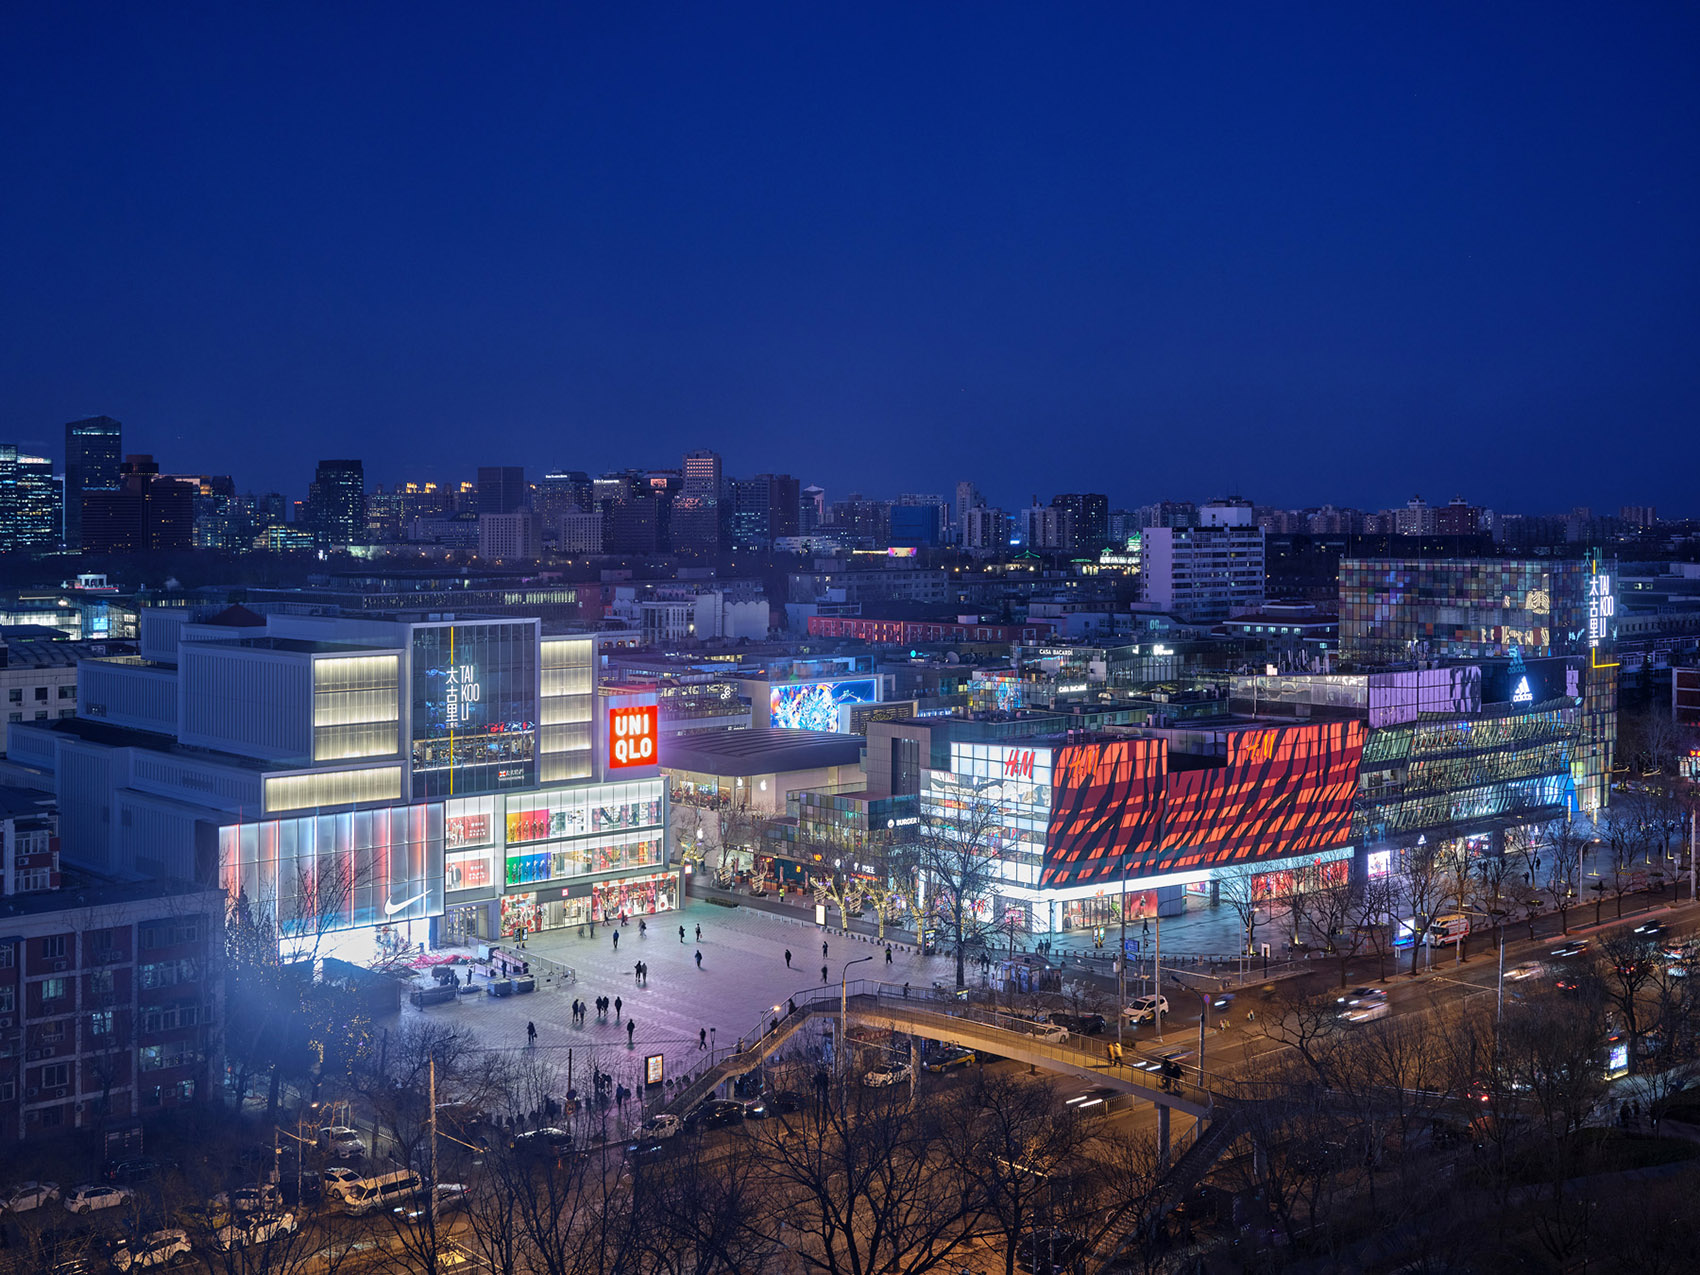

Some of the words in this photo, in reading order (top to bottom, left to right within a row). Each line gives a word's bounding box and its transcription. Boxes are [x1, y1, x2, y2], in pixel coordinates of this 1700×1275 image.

[1599, 575, 1609, 595] TAI
[1589, 576, 1599, 638] 太古里
[1600, 596, 1613, 616] KOO
[460, 665, 473, 683] TAI
[445, 666, 459, 721] 太古里
[461, 683, 480, 702] KOO
[1513, 693, 1533, 702] adidas
[615, 714, 649, 737] UNI
[615, 737, 653, 763] QLO
[1004, 749, 1035, 779] H&M
[1068, 749, 1100, 777] H&M
[896, 817, 917, 826] BURGER
